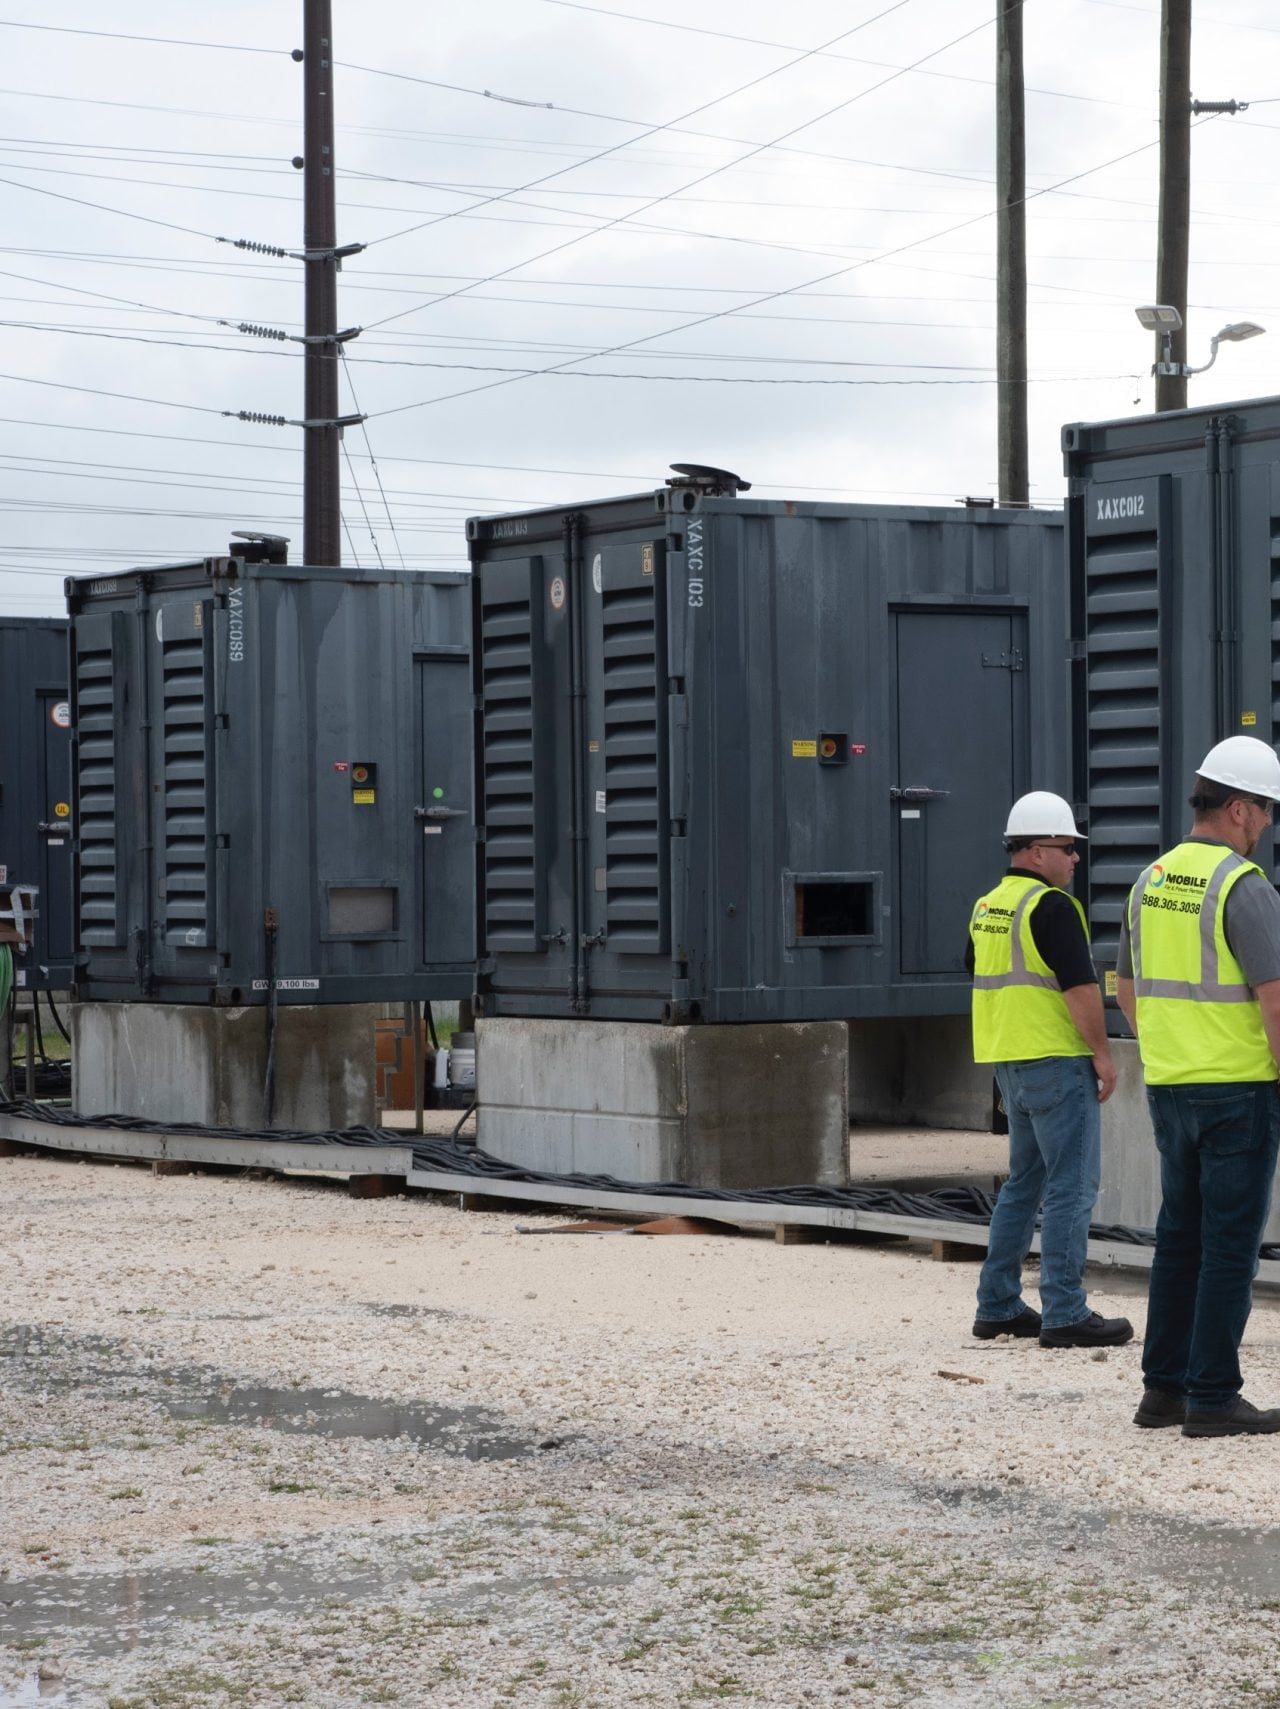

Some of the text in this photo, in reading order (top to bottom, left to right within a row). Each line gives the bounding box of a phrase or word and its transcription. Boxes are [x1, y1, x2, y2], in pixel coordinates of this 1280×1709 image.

[1097, 494, 1144, 520] XAXC012
[687, 519, 704, 608] XAXC 103
[1166, 873, 1207, 888] MOBILE
[988, 907, 1016, 917] MOBILE
